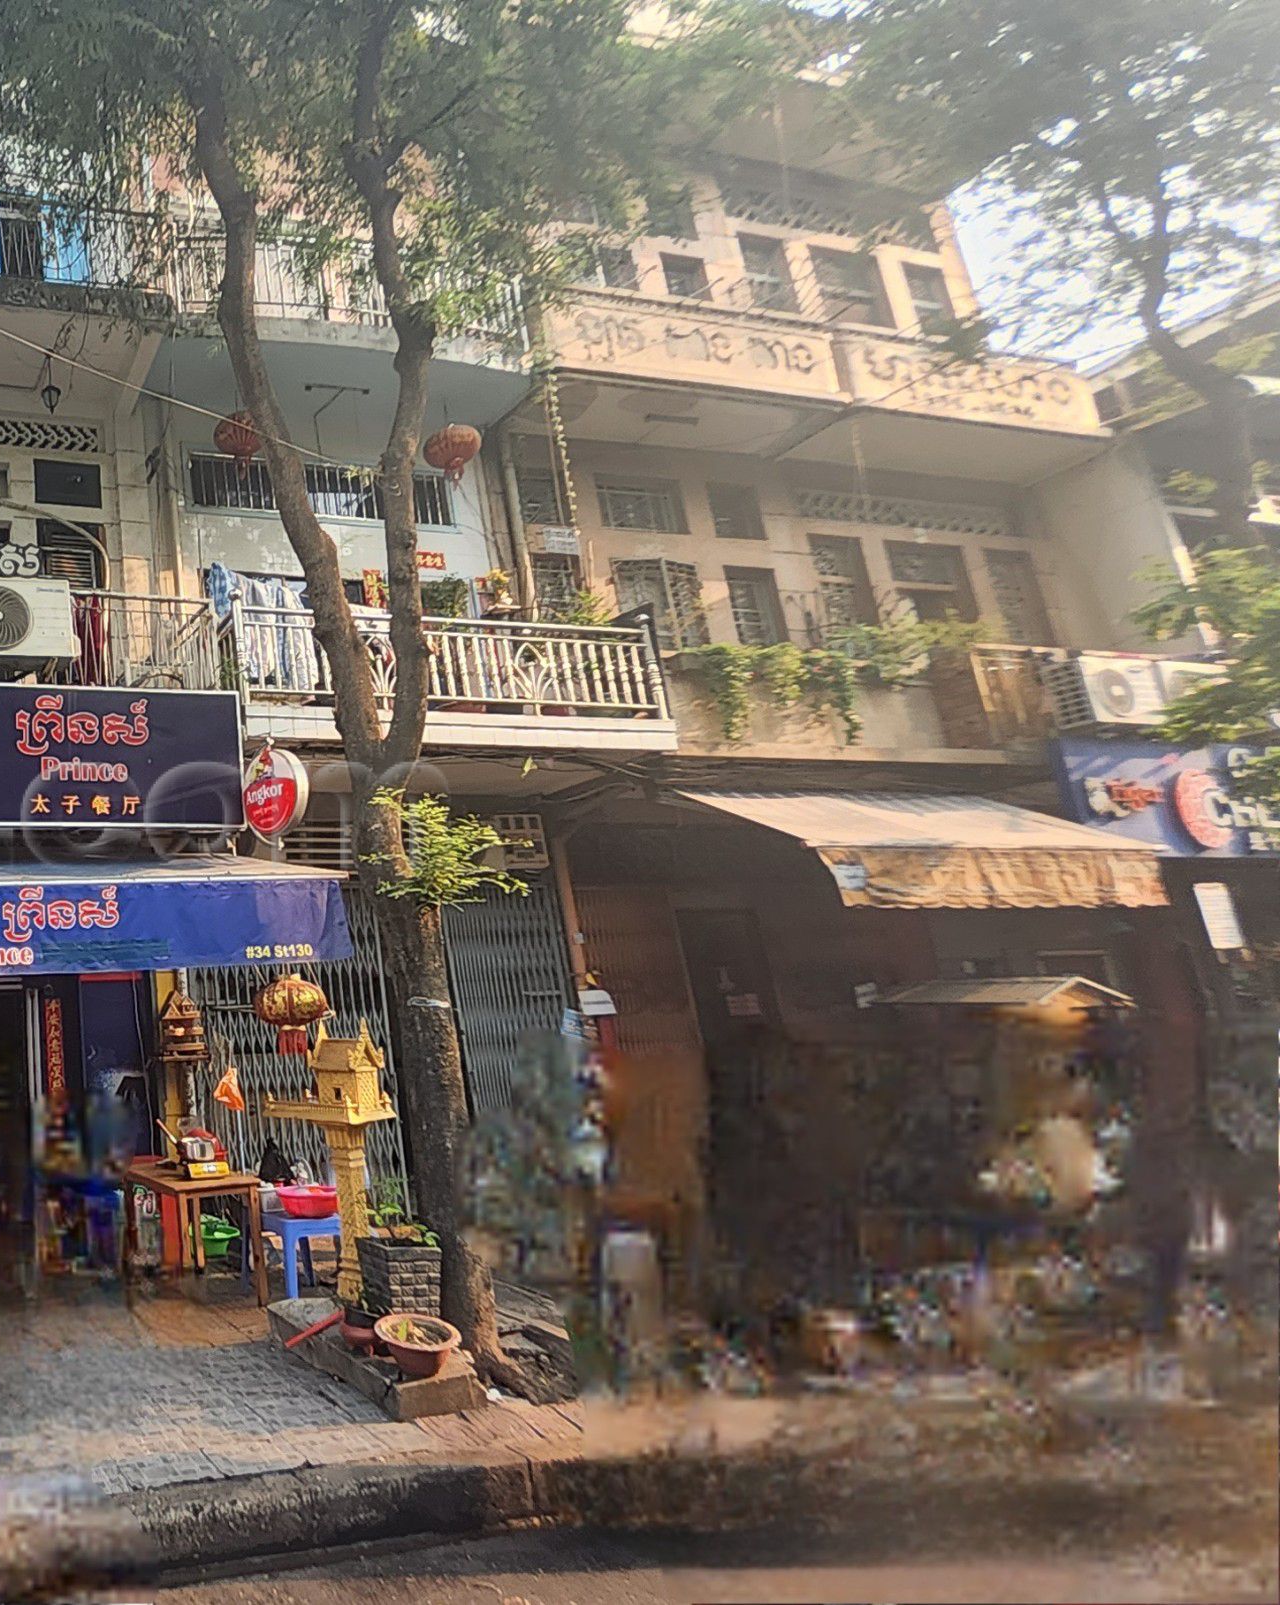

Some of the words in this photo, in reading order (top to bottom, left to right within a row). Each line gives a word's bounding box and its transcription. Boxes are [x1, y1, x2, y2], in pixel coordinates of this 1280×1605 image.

[40, 756, 128, 783] Prince
[30, 794, 142, 816] 太子餐厅
[245, 783, 284, 806] Angkor
[245, 945, 271, 959] #34
[274, 943, 313, 958] St130
